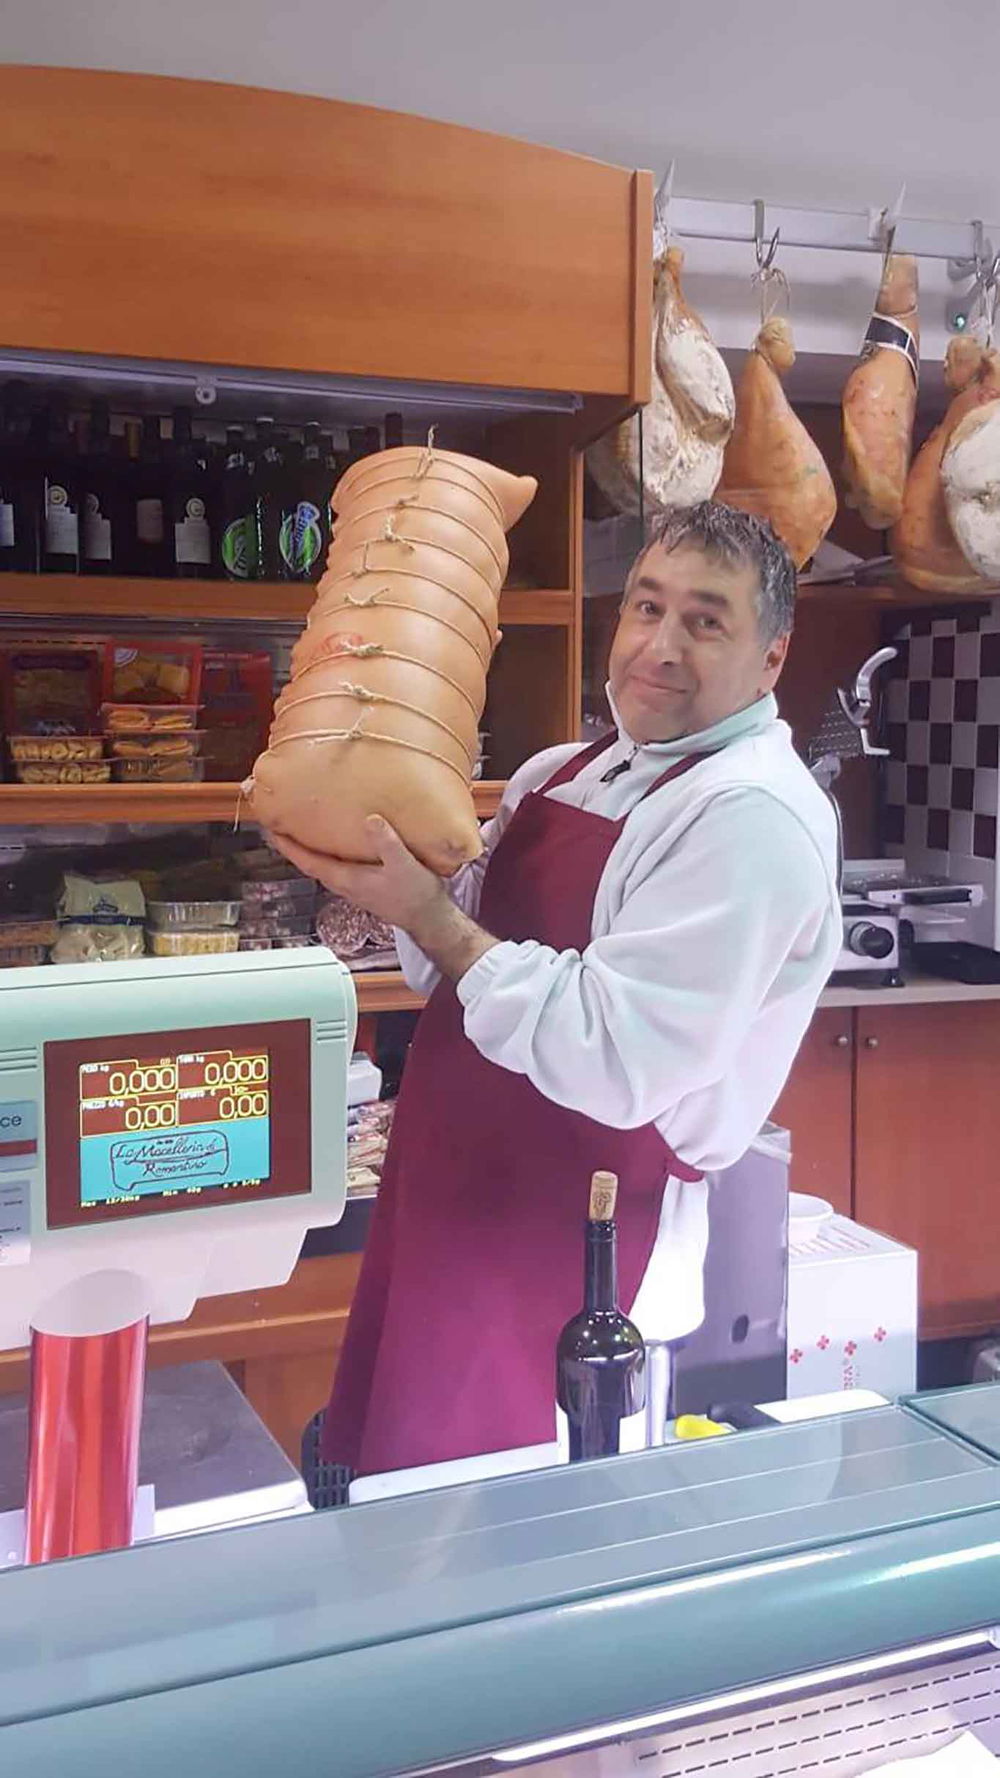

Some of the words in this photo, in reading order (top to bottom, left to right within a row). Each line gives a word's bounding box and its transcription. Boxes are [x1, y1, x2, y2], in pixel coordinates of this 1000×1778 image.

[109, 1068, 175, 1096] 0,000
[205, 1058, 266, 1086] 0,000
[125, 1103, 175, 1130] 0,00
[219, 1093, 266, 1119] 0,00
[115, 1144, 136, 1159] La
[134, 1137, 205, 1161] Macelleria
